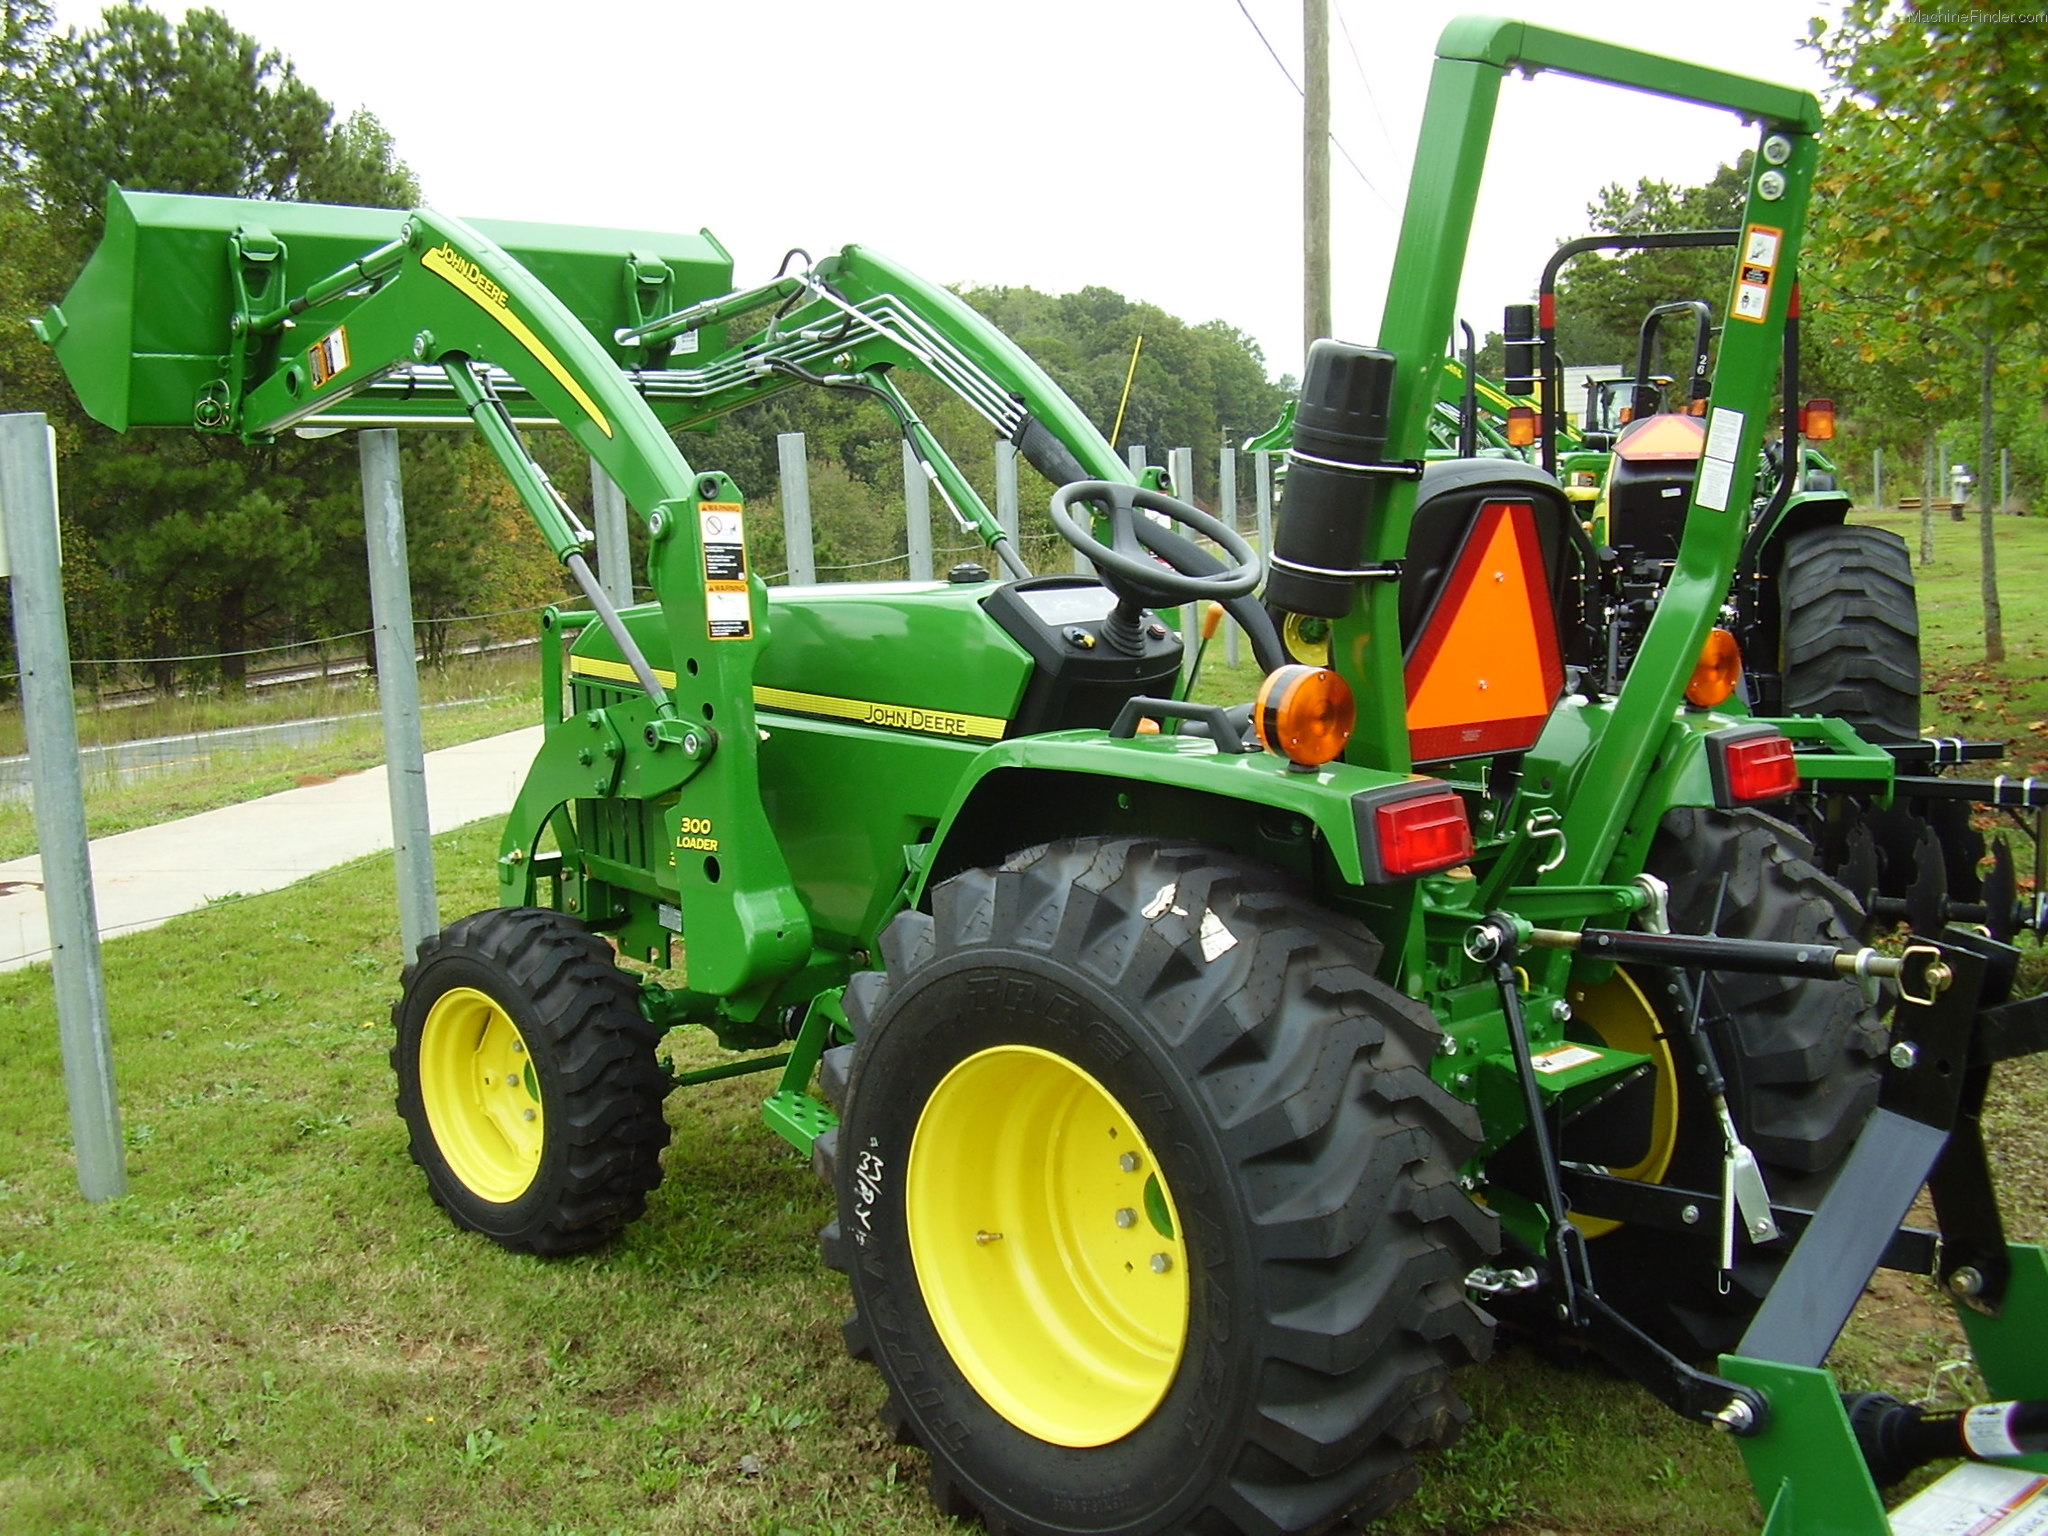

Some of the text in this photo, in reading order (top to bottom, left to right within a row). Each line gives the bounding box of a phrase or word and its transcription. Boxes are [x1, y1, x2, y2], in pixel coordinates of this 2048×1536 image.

[436, 241, 510, 310] JOHN DEERE
[864, 704, 967, 734] JOHN DEERE
[681, 816, 711, 835] 300
[676, 836, 718, 852] LOADER
